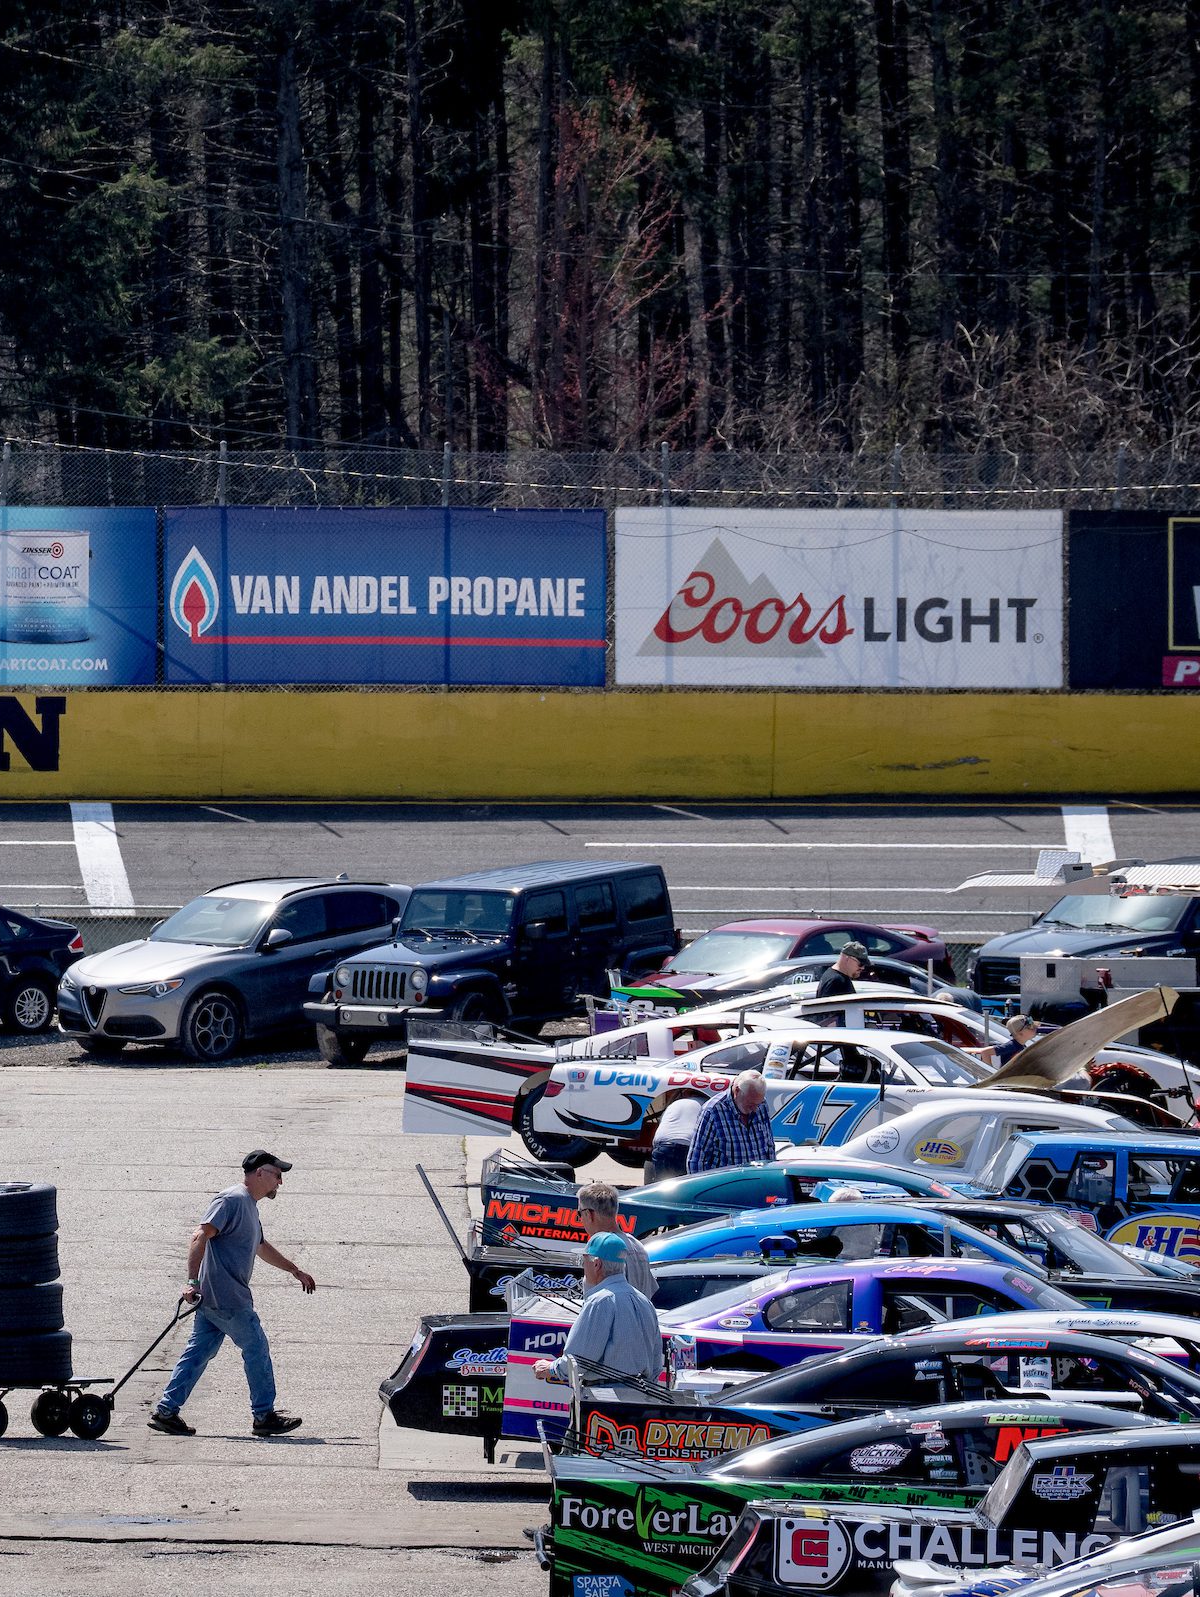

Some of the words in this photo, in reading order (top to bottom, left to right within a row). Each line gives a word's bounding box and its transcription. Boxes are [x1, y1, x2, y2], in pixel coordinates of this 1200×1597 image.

[230, 575, 299, 614] VAN
[310, 576, 417, 615] ANDEL
[428, 577, 585, 616] PROPANE
[653, 571, 854, 644] Coors
[864, 597, 1038, 643] LIGHT
[594, 1070, 662, 1092] Daily
[667, 1071, 731, 1092] Dea
[769, 1084, 886, 1148] 47
[521, 1114, 547, 1158] Hoosier
[490, 1191, 530, 1203] WEST
[486, 1199, 638, 1234] MICHIGN
[461, 1365, 484, 1376] BAR
[481, 1386, 504, 1404] M
[532, 1400, 569, 1412] CUTL
[480, 1405, 504, 1414] Transp
[646, 1423, 769, 1450] DYKEMA
[643, 1542, 675, 1553] WEST
[854, 1523, 1125, 1569] CHALLENG
[576, 1576, 621, 1589] SPARTA
